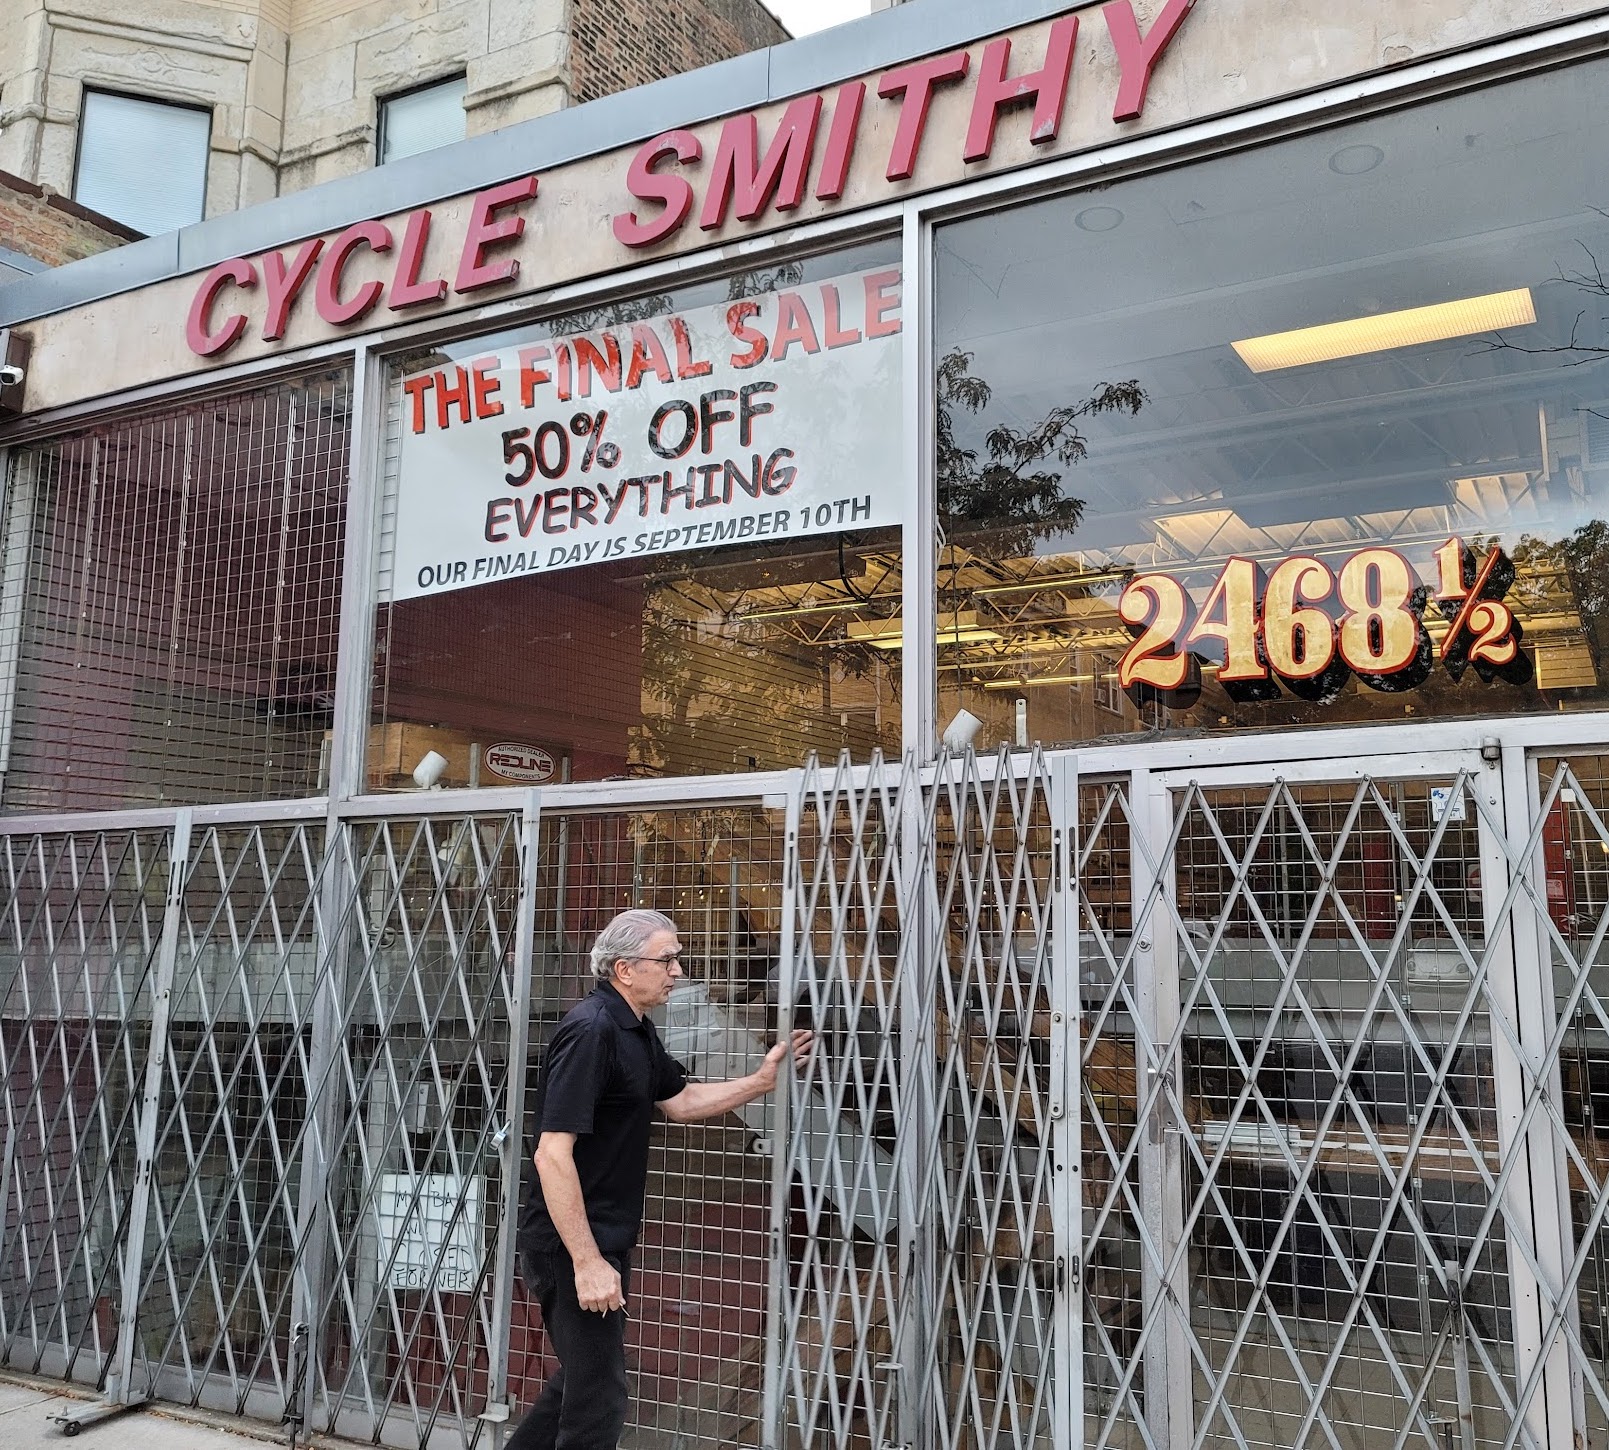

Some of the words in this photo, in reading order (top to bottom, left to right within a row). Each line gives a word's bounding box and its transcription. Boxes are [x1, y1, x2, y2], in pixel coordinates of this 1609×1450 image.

[185, 176, 538, 357] CYCLE
[613, 0, 1196, 248] SMITHY
[405, 356, 504, 435] THE
[518, 315, 712, 409] FINAL
[726, 269, 903, 369] SALE
[502, 410, 621, 487] 50%
[648, 381, 778, 460] OFF
[418, 561, 467, 588] OUR
[472, 551, 540, 581] FINAL
[547, 541, 599, 567] DAY
[602, 536, 627, 558] IS
[630, 510, 790, 553] SEPTEMBER
[800, 495, 871, 529] 10TH
[485, 447, 797, 543] EVERYTHING
[1118, 546, 1420, 690] 2468
[489, 752, 552, 773] REDLINE
